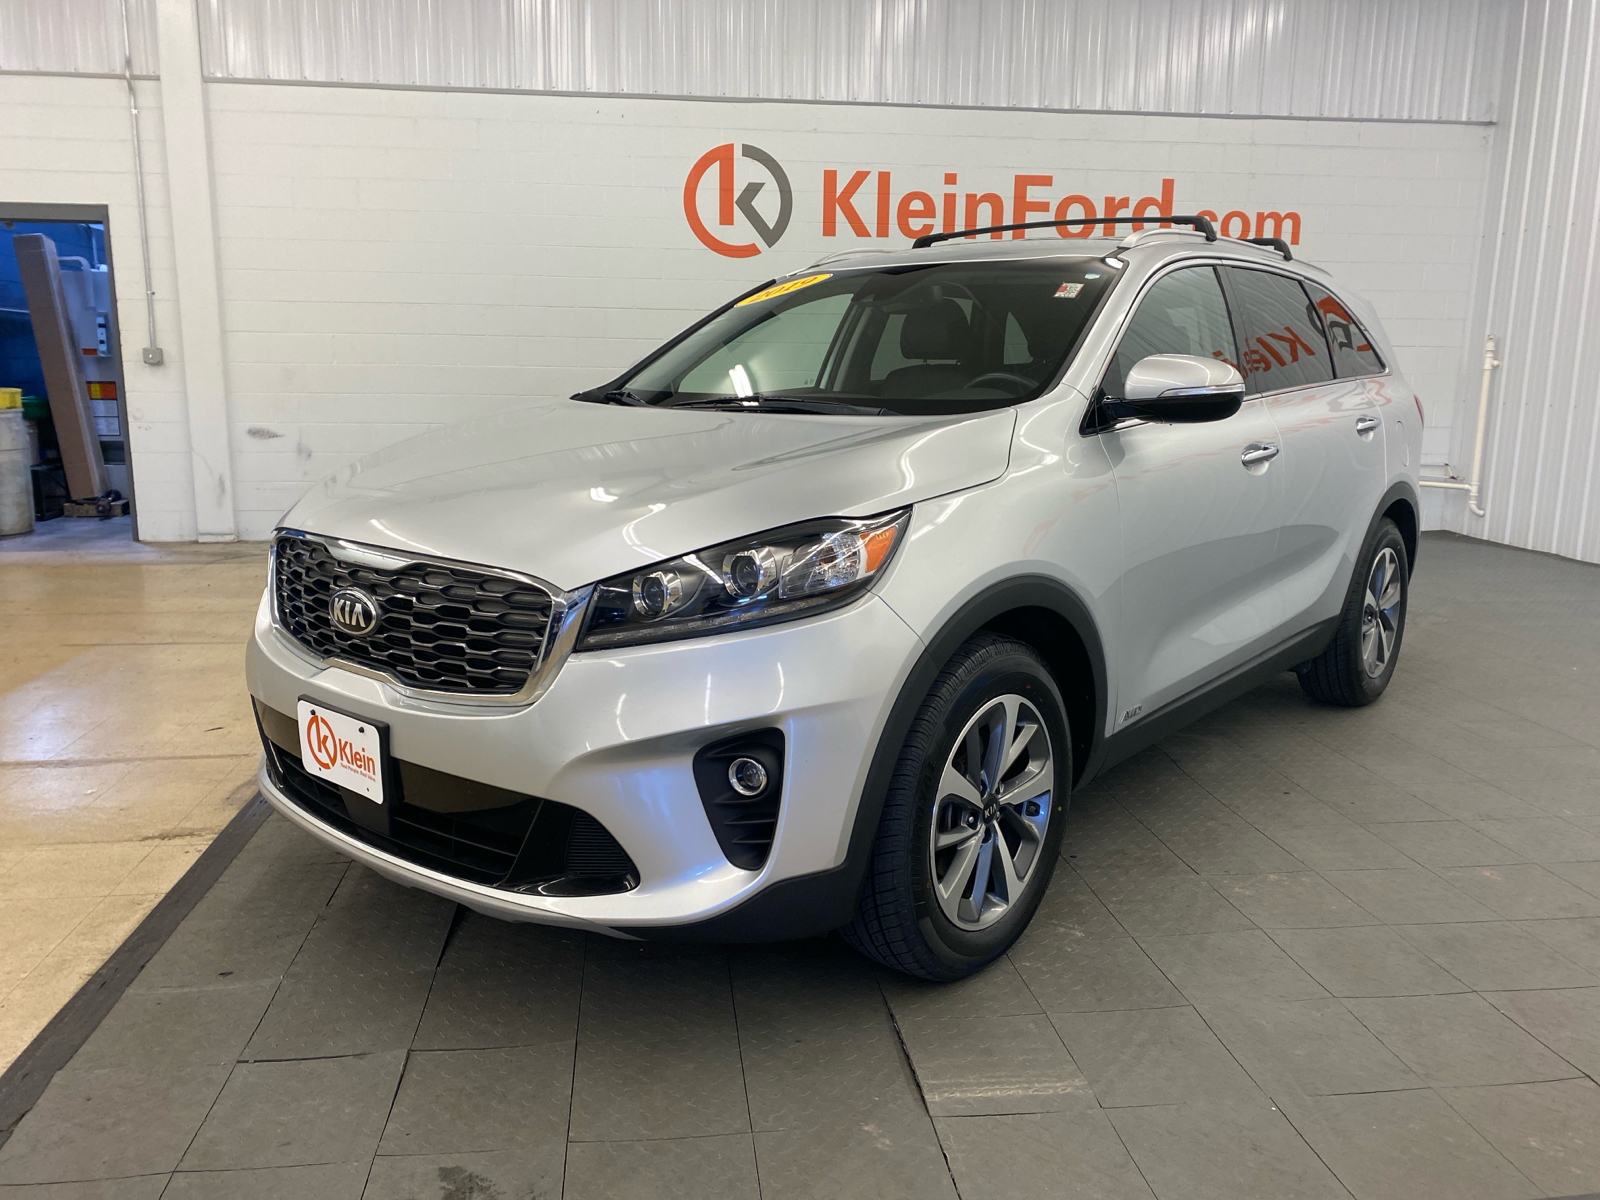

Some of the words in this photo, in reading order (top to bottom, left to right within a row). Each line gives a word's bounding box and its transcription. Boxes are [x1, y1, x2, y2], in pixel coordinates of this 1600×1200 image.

[822, 169, 1301, 246] KleinFordcom
[333, 597, 366, 628] KIA
[338, 737, 376, 776] Klein
[984, 803, 997, 819] KIA
